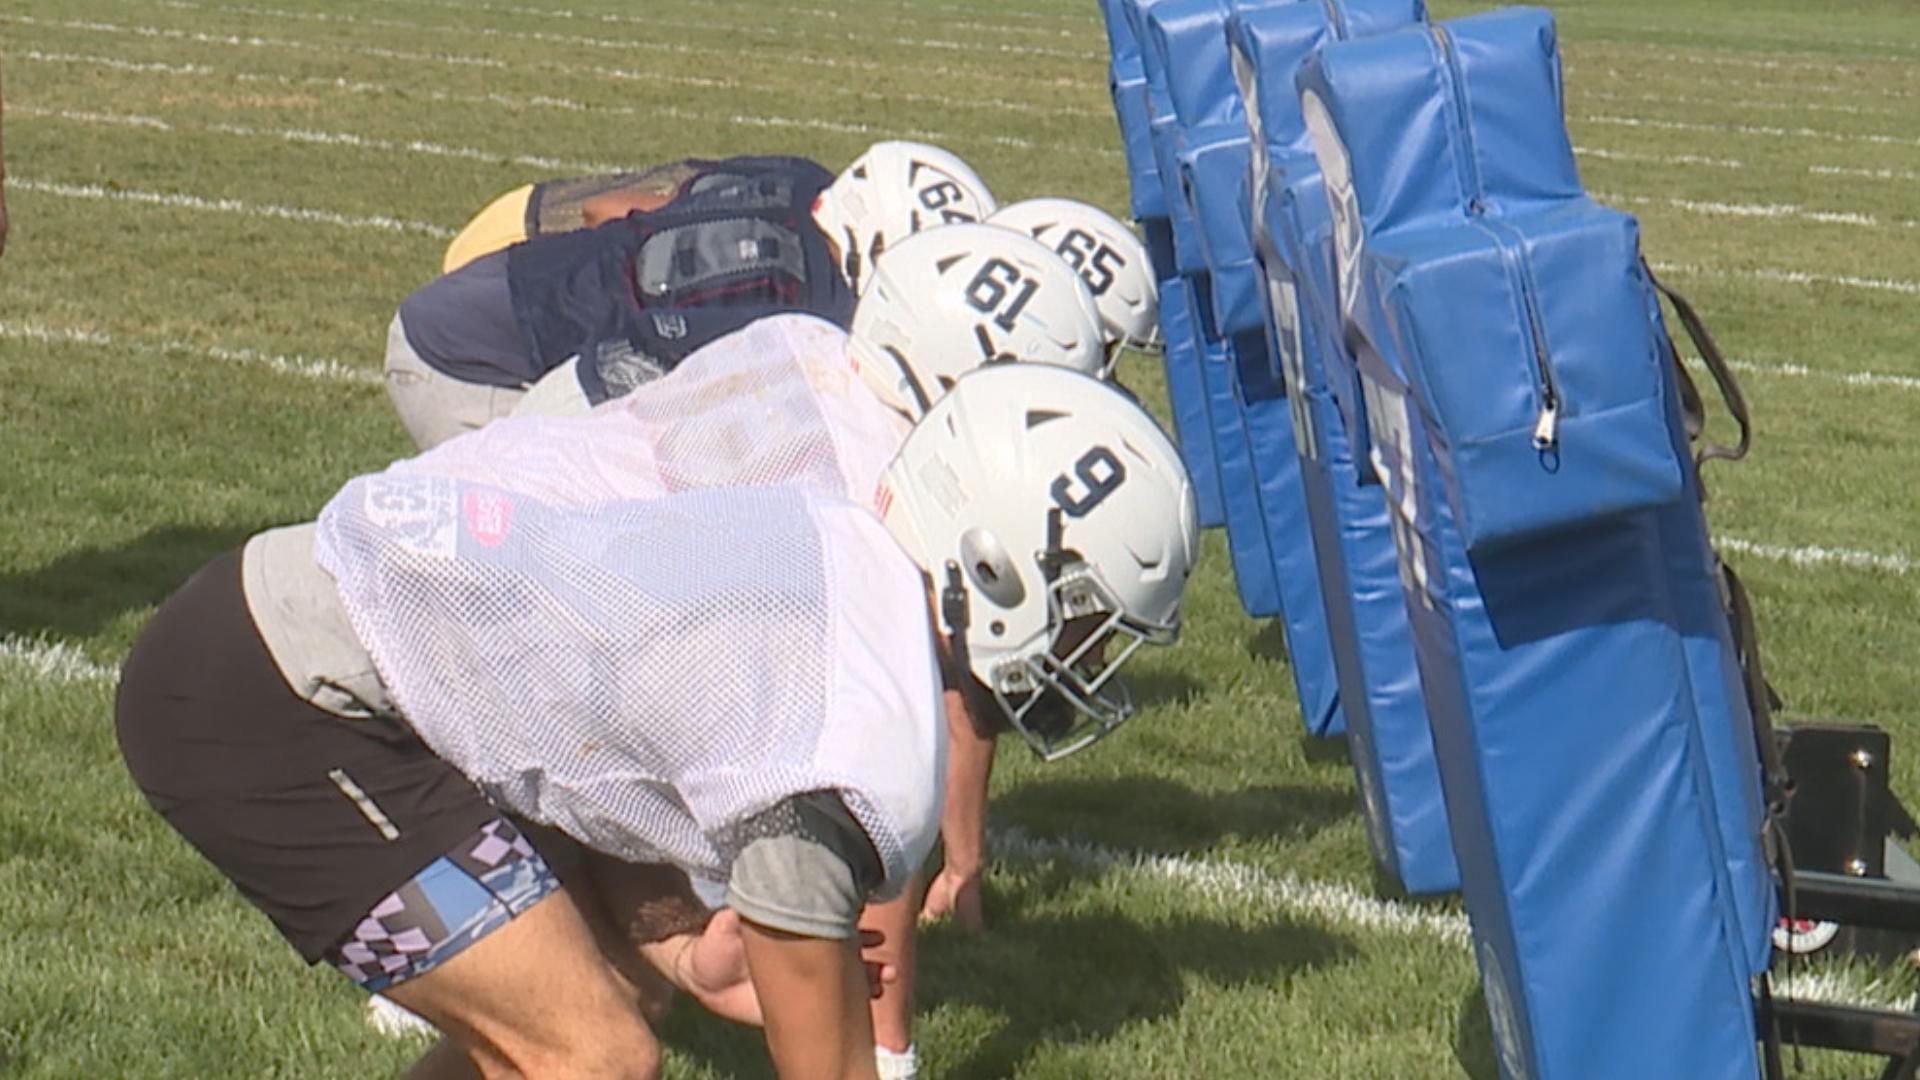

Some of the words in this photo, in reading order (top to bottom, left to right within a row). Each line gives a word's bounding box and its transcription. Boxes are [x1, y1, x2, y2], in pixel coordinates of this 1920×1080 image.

[965, 258, 1040, 332] 61
[1056, 229, 1126, 296] 65
[1051, 445, 1126, 518] 9
